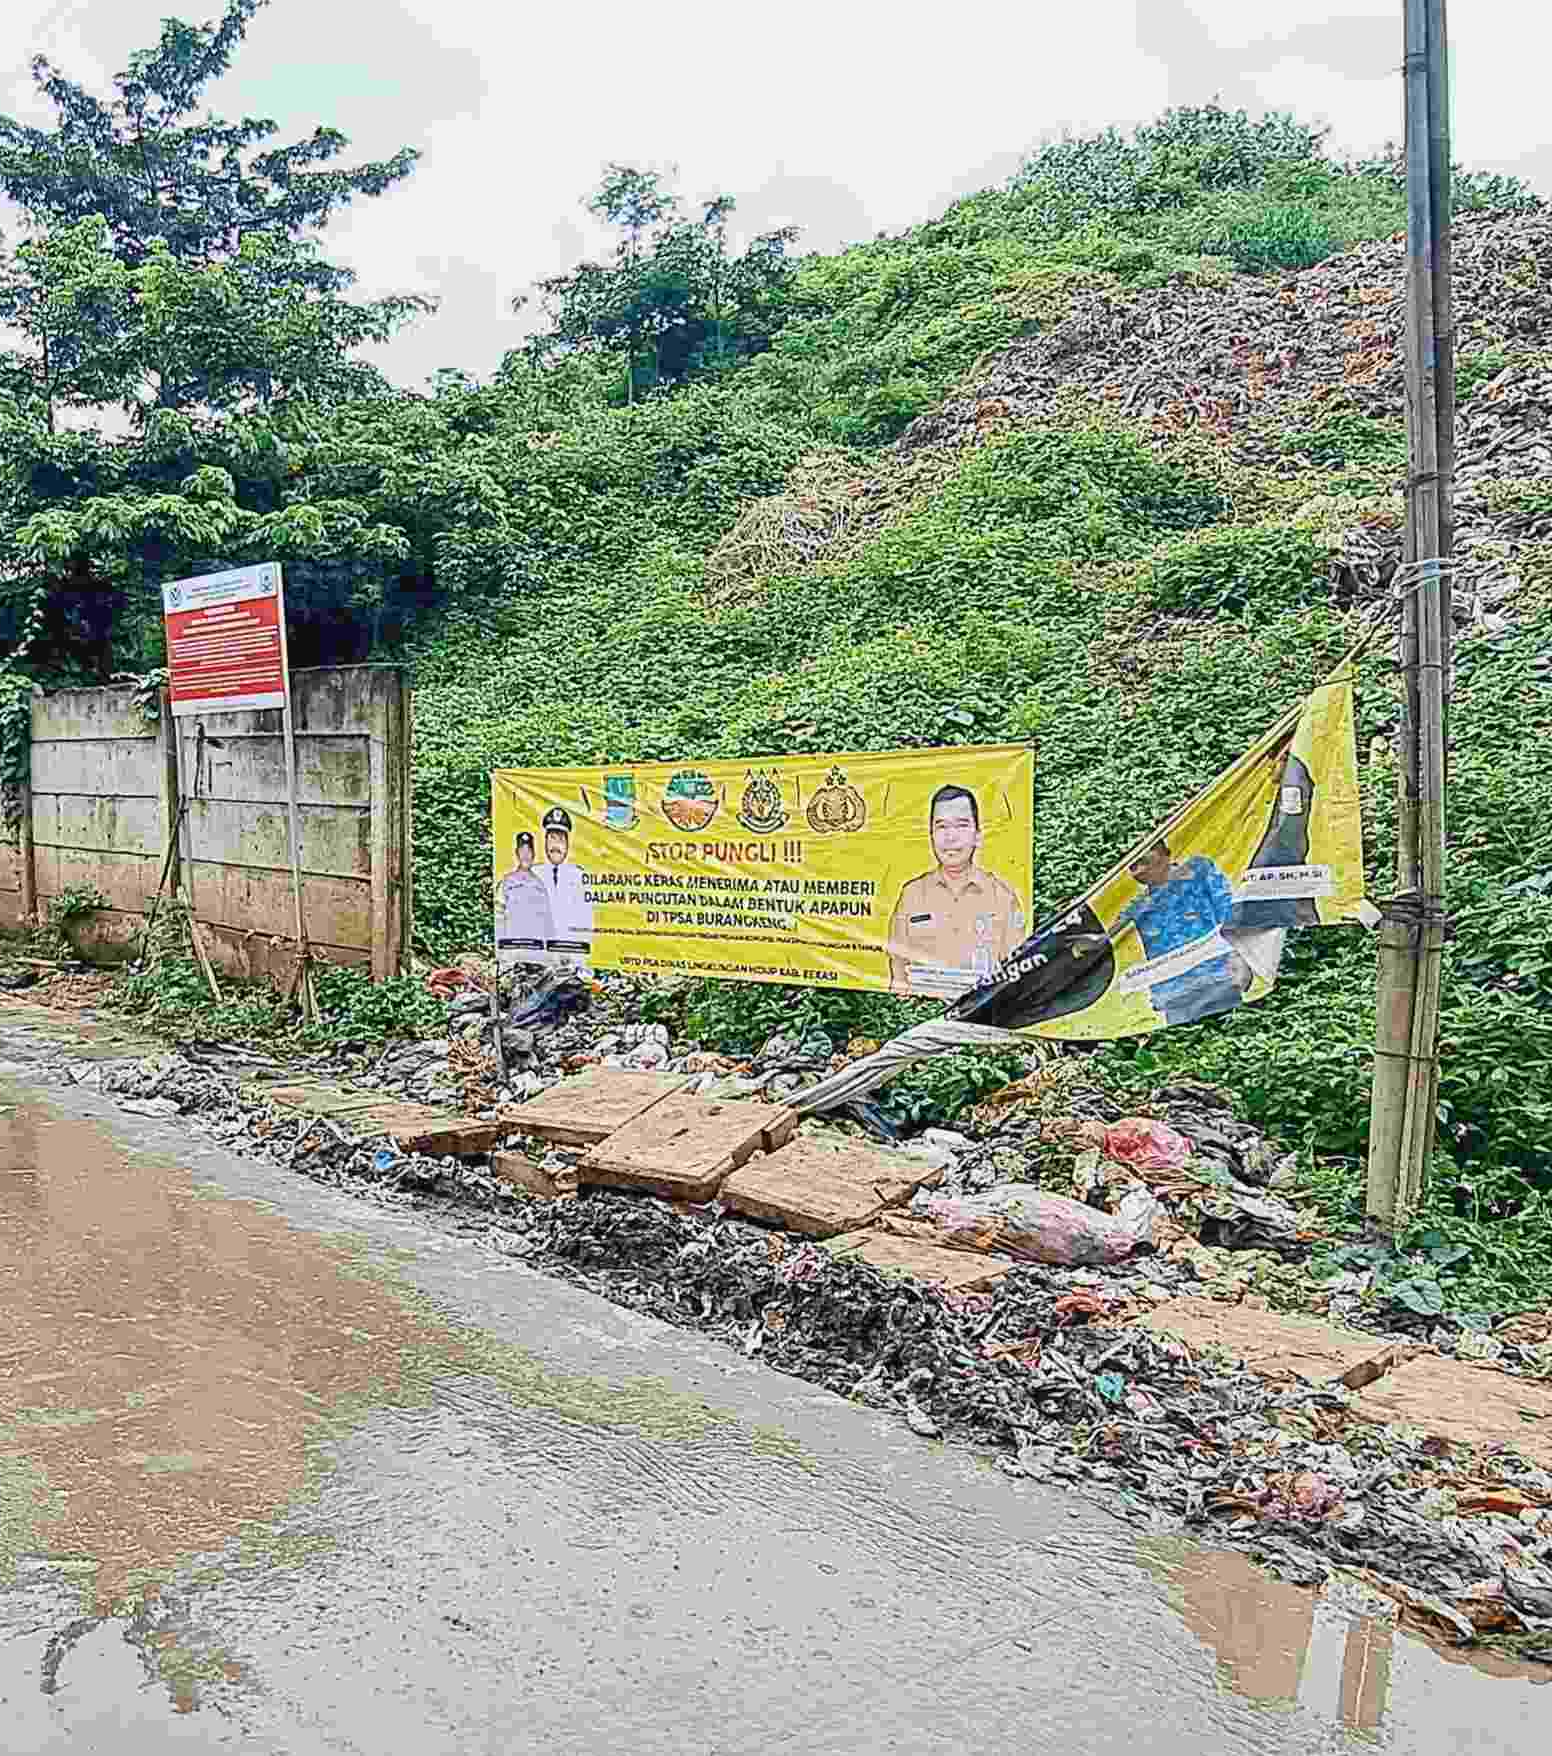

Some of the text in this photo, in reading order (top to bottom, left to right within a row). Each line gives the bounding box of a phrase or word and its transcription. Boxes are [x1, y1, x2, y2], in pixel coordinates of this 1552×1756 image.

[703, 840, 776, 863] PUNGLI
[581, 872, 875, 896] DILARANG KERAS MENERIMA ATAU MEMBERI
[584, 891, 626, 903] DALAM
[699, 895, 744, 909] DALAM
[747, 898, 806, 913] BENTUK
[809, 901, 872, 917] APAPUN
[647, 911, 659, 923] DI
[661, 912, 694, 926] TPSA
